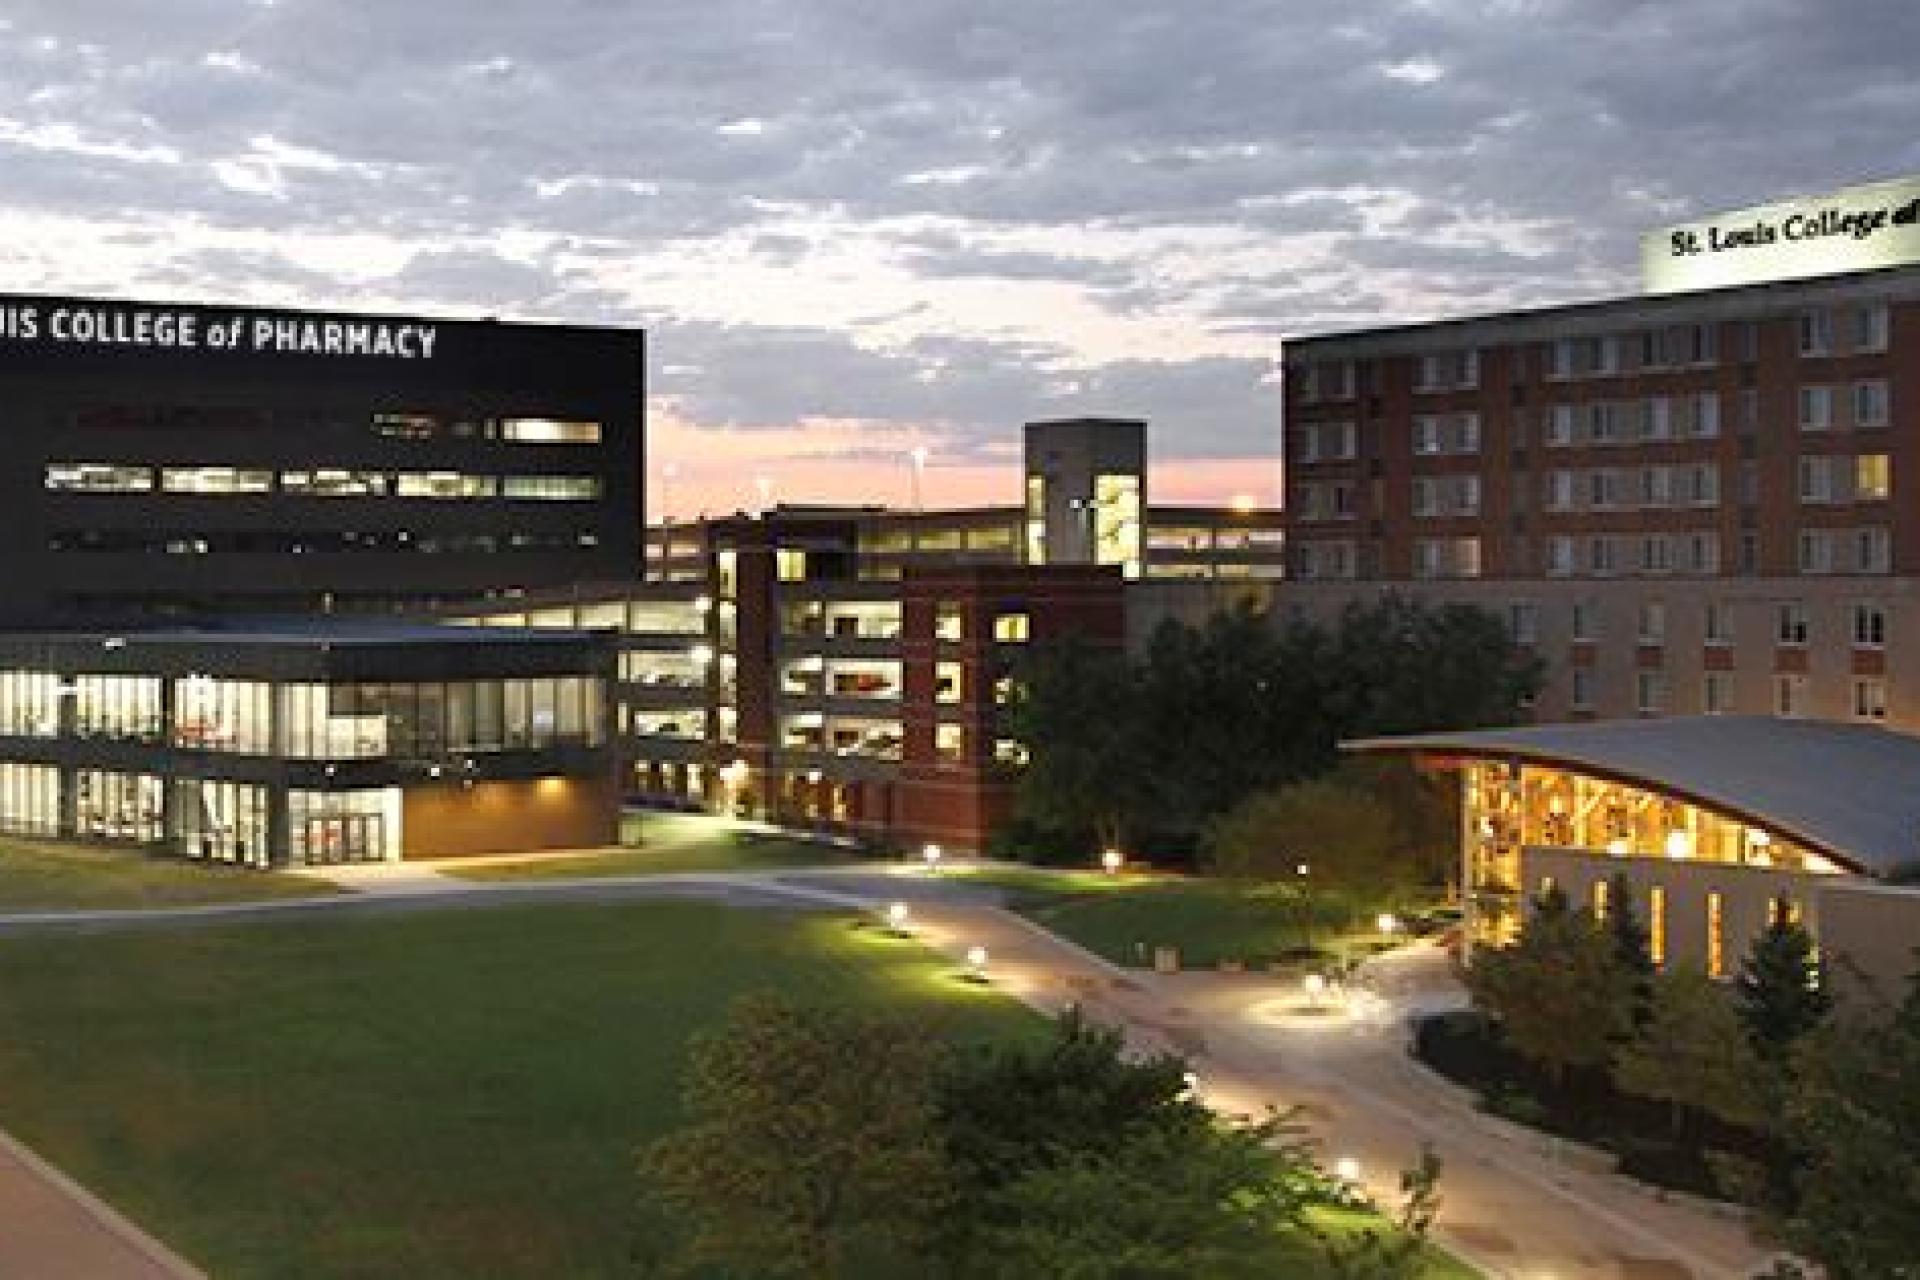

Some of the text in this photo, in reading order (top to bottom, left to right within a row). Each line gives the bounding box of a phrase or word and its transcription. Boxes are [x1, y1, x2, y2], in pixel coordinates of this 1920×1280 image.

[1709, 221, 1776, 252] Louis
[1783, 208, 1888, 240] College
[0, 305, 437, 358] IS COLLEGE of PHARMACY
